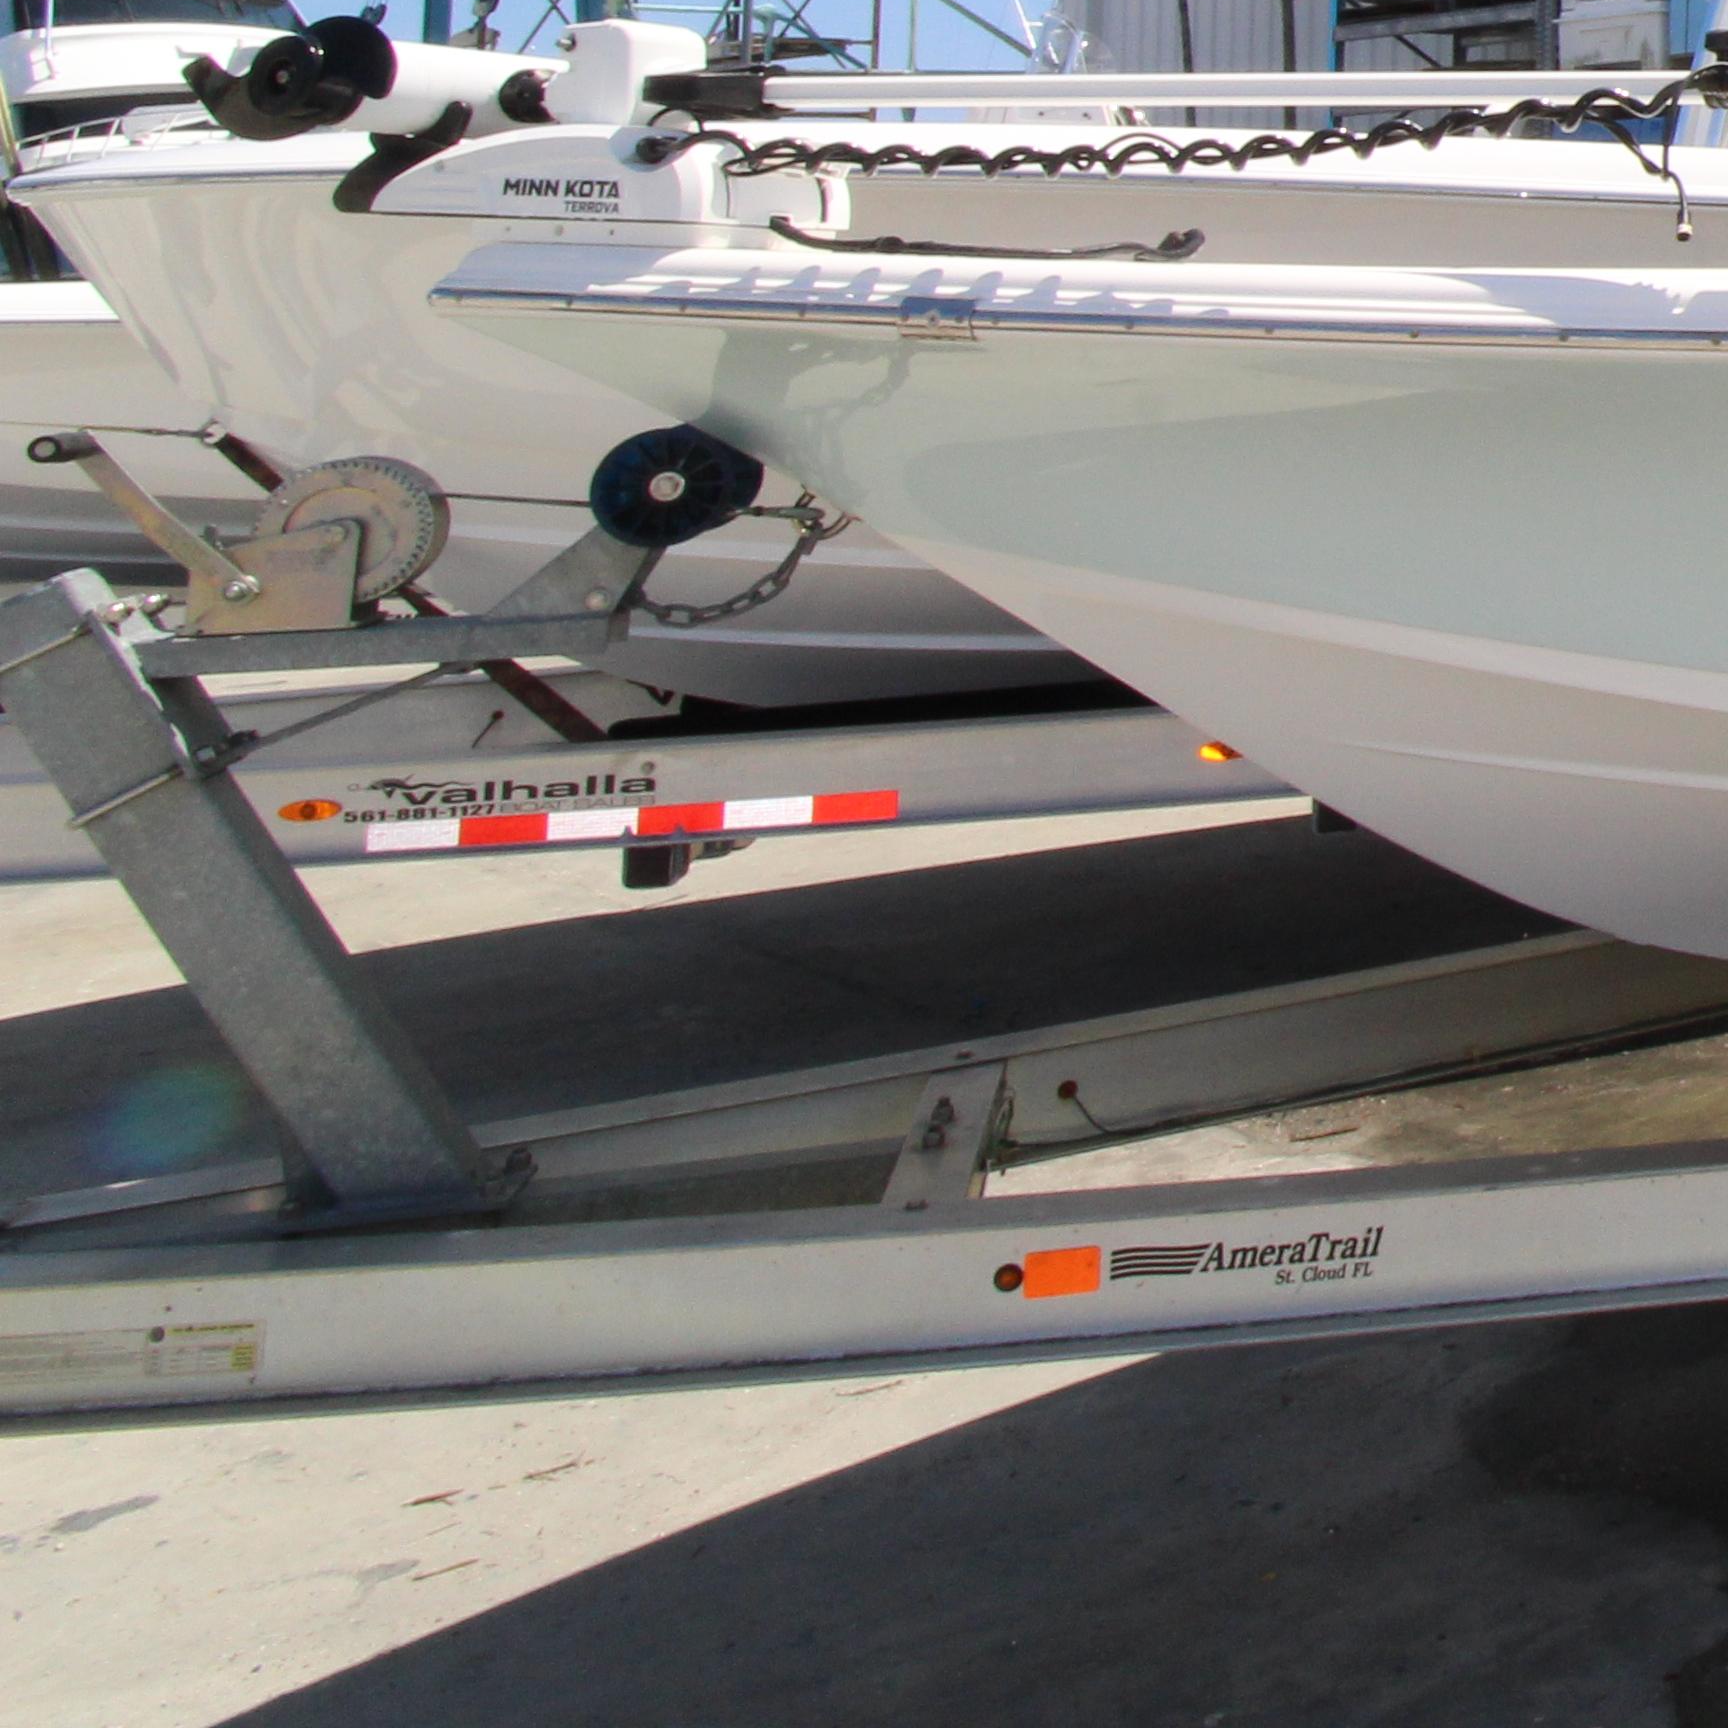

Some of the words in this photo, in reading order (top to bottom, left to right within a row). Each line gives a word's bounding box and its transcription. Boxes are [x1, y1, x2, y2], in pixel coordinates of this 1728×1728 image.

[503, 179, 559, 196] MINN
[564, 180, 619, 198] KOTA
[564, 201, 619, 213] TERROVA
[344, 803, 494, 823] 561-881-1127
[1200, 1225, 1384, 1272] AmeraTrail
[1274, 1269, 1295, 1285] St.
[1302, 1266, 1347, 1282] Cloud
[1351, 1261, 1373, 1278] FL
